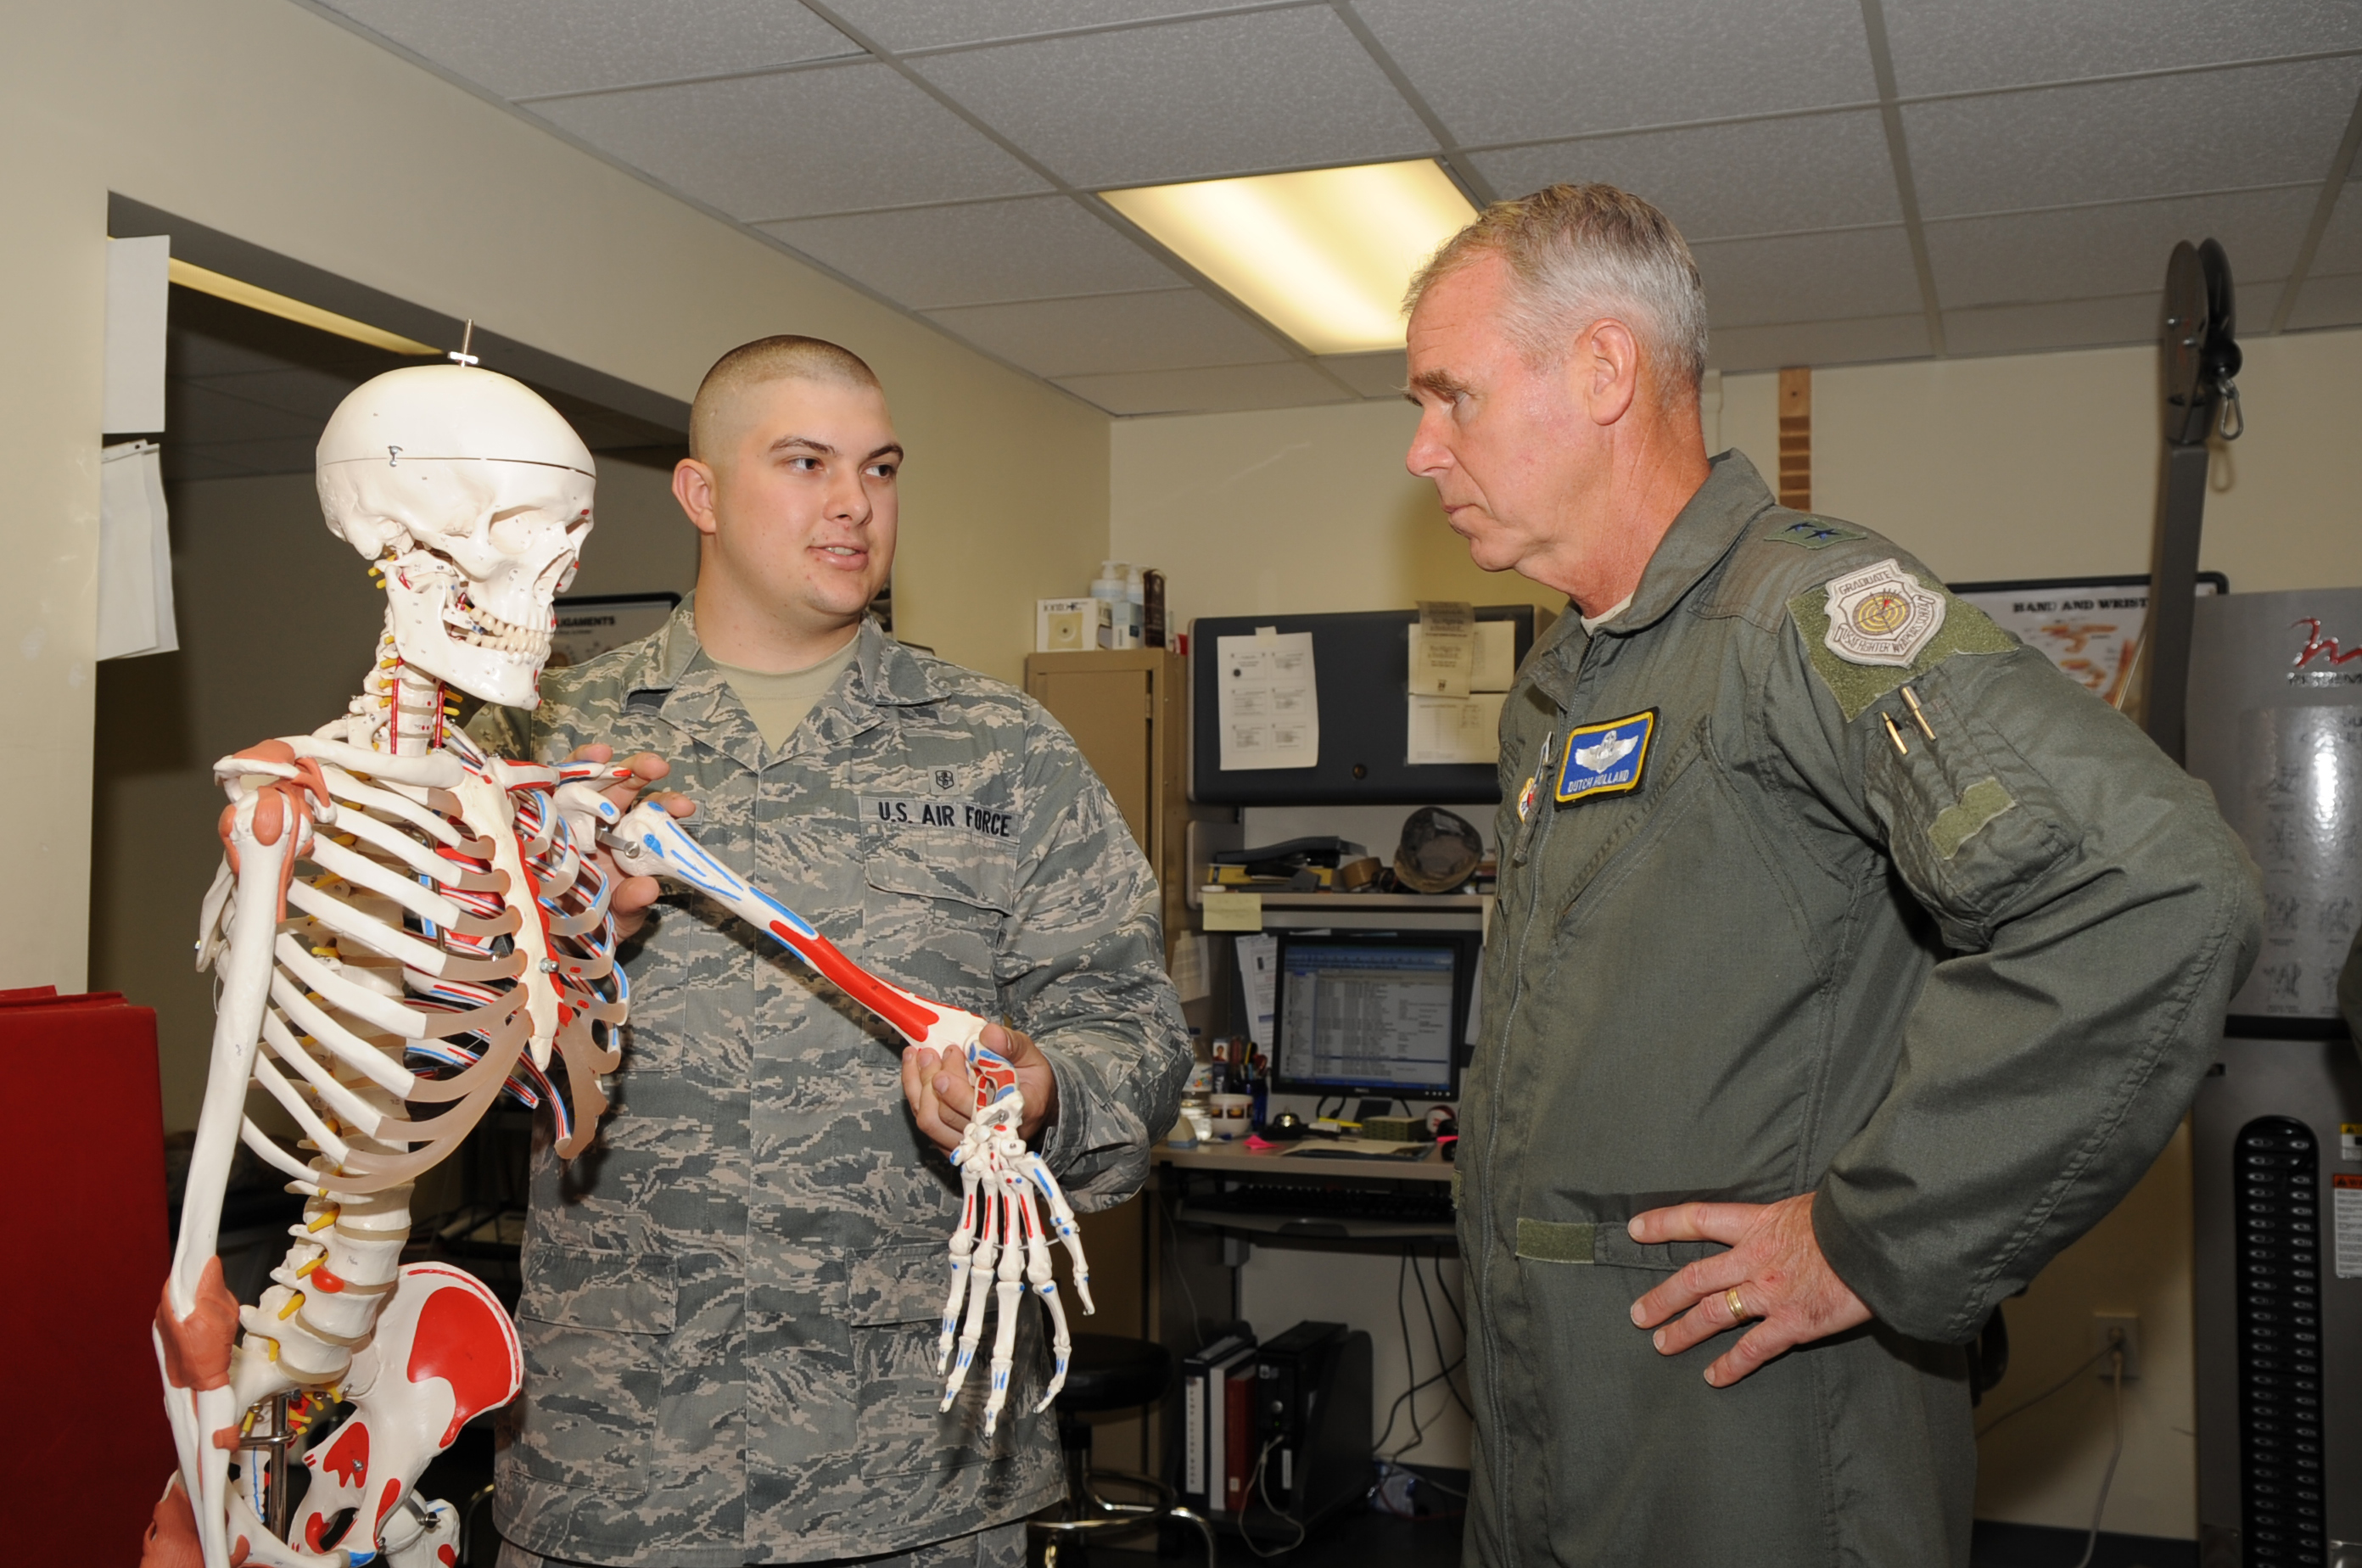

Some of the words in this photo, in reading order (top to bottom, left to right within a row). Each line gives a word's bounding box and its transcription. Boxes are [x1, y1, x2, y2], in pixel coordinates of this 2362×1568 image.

[1839, 571, 1889, 594] GRADUATE
[2013, 601, 2057, 613] HAND
[2062, 599, 2095, 611] AND
[2098, 597, 2148, 609] WRIST
[1858, 639, 1891, 652] FIGHTER
[1568, 777, 1593, 792] DUTCH
[1593, 770, 1629, 786] HOLLAND
[878, 801, 913, 824] U.S.
[921, 804, 955, 827] AIR
[966, 805, 1013, 837] FORCE
